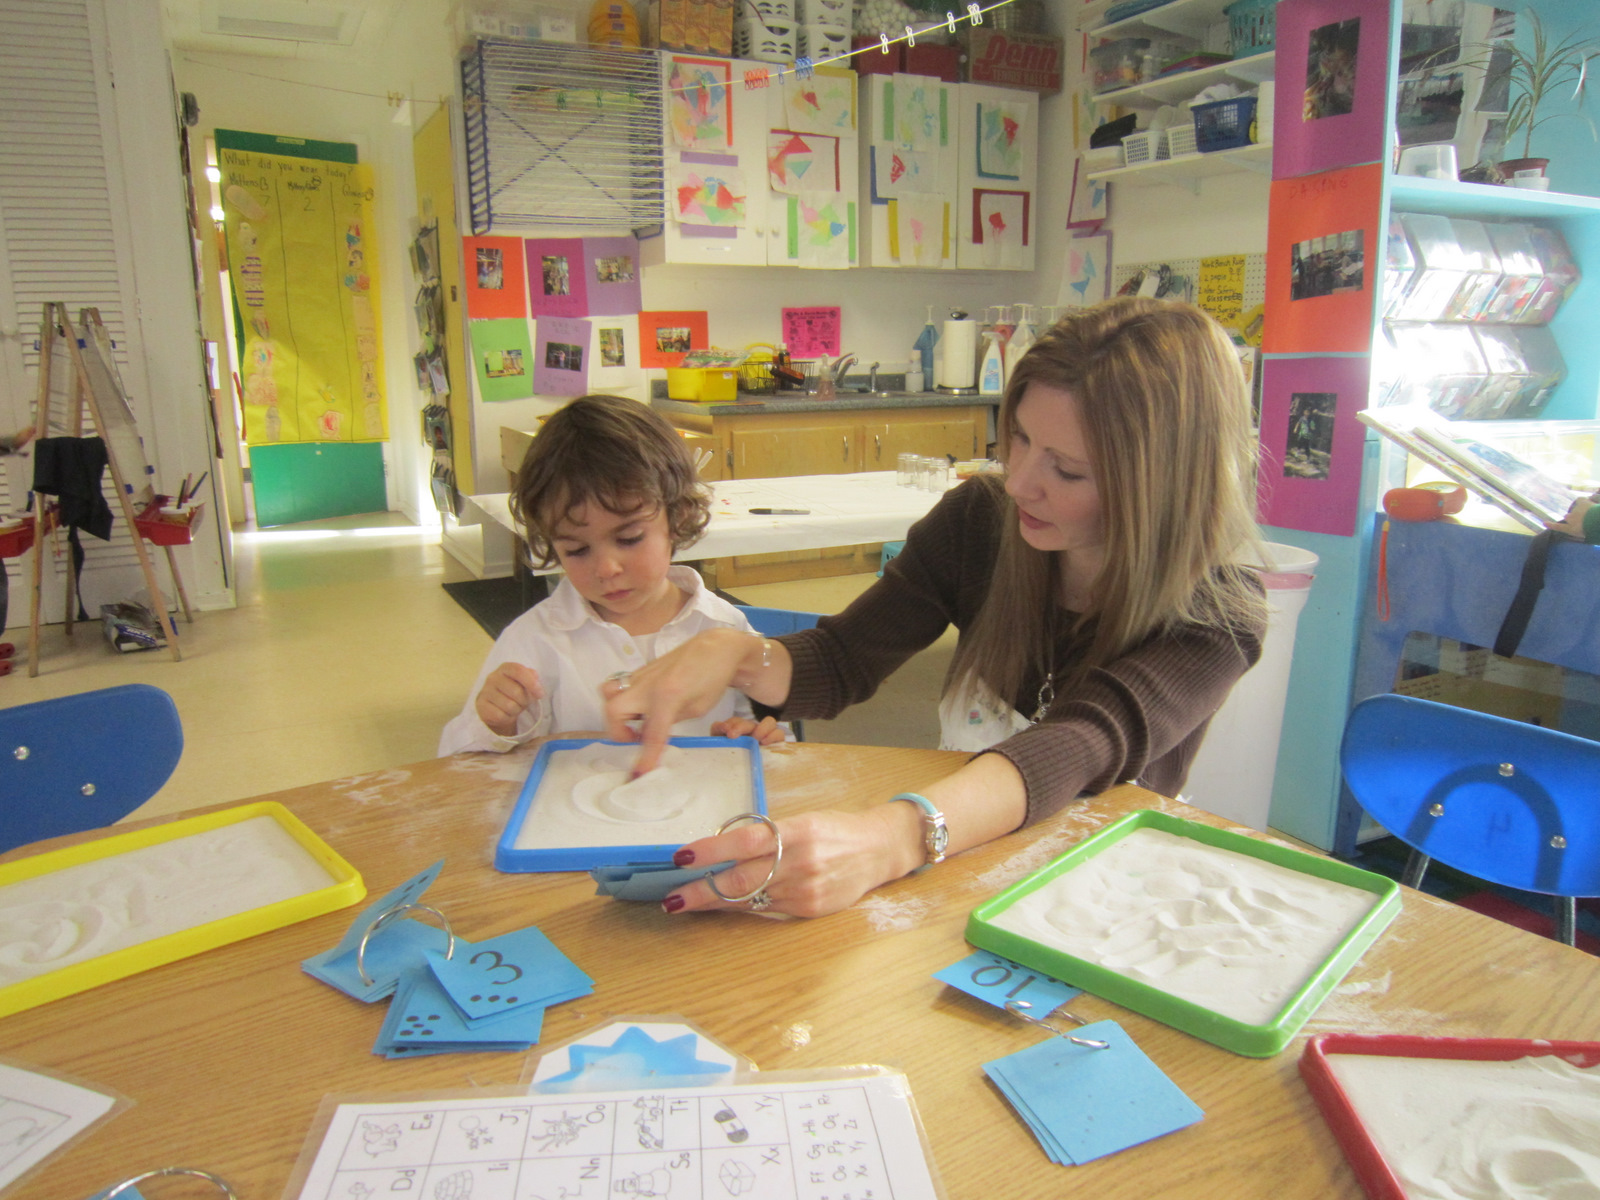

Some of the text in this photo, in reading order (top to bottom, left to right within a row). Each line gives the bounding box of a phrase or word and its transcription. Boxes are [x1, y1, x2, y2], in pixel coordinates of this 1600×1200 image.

[975, 35, 1058, 71] Penn
[992, 69, 1049, 88] TENNIS BALLS
[224, 151, 250, 167] What
[258, 158, 272, 170] did
[278, 162, 293, 175] you
[300, 165, 318, 174] wear
[303, 197, 316, 212] 2
[469, 950, 523, 985] 3
[971, 965, 1037, 999] 10
[670, 1100, 689, 1116] Tt
[754, 1095, 781, 1112] Yy
[410, 1113, 434, 1131] Ee
[499, 1108, 529, 1125] Jj
[585, 1104, 606, 1124] Oo
[670, 1152, 690, 1169] Ss
[760, 1146, 781, 1165] Xx
[806, 1143, 825, 1160] Gg
[579, 1157, 600, 1180] Nn
[390, 1169, 417, 1191] Dd
